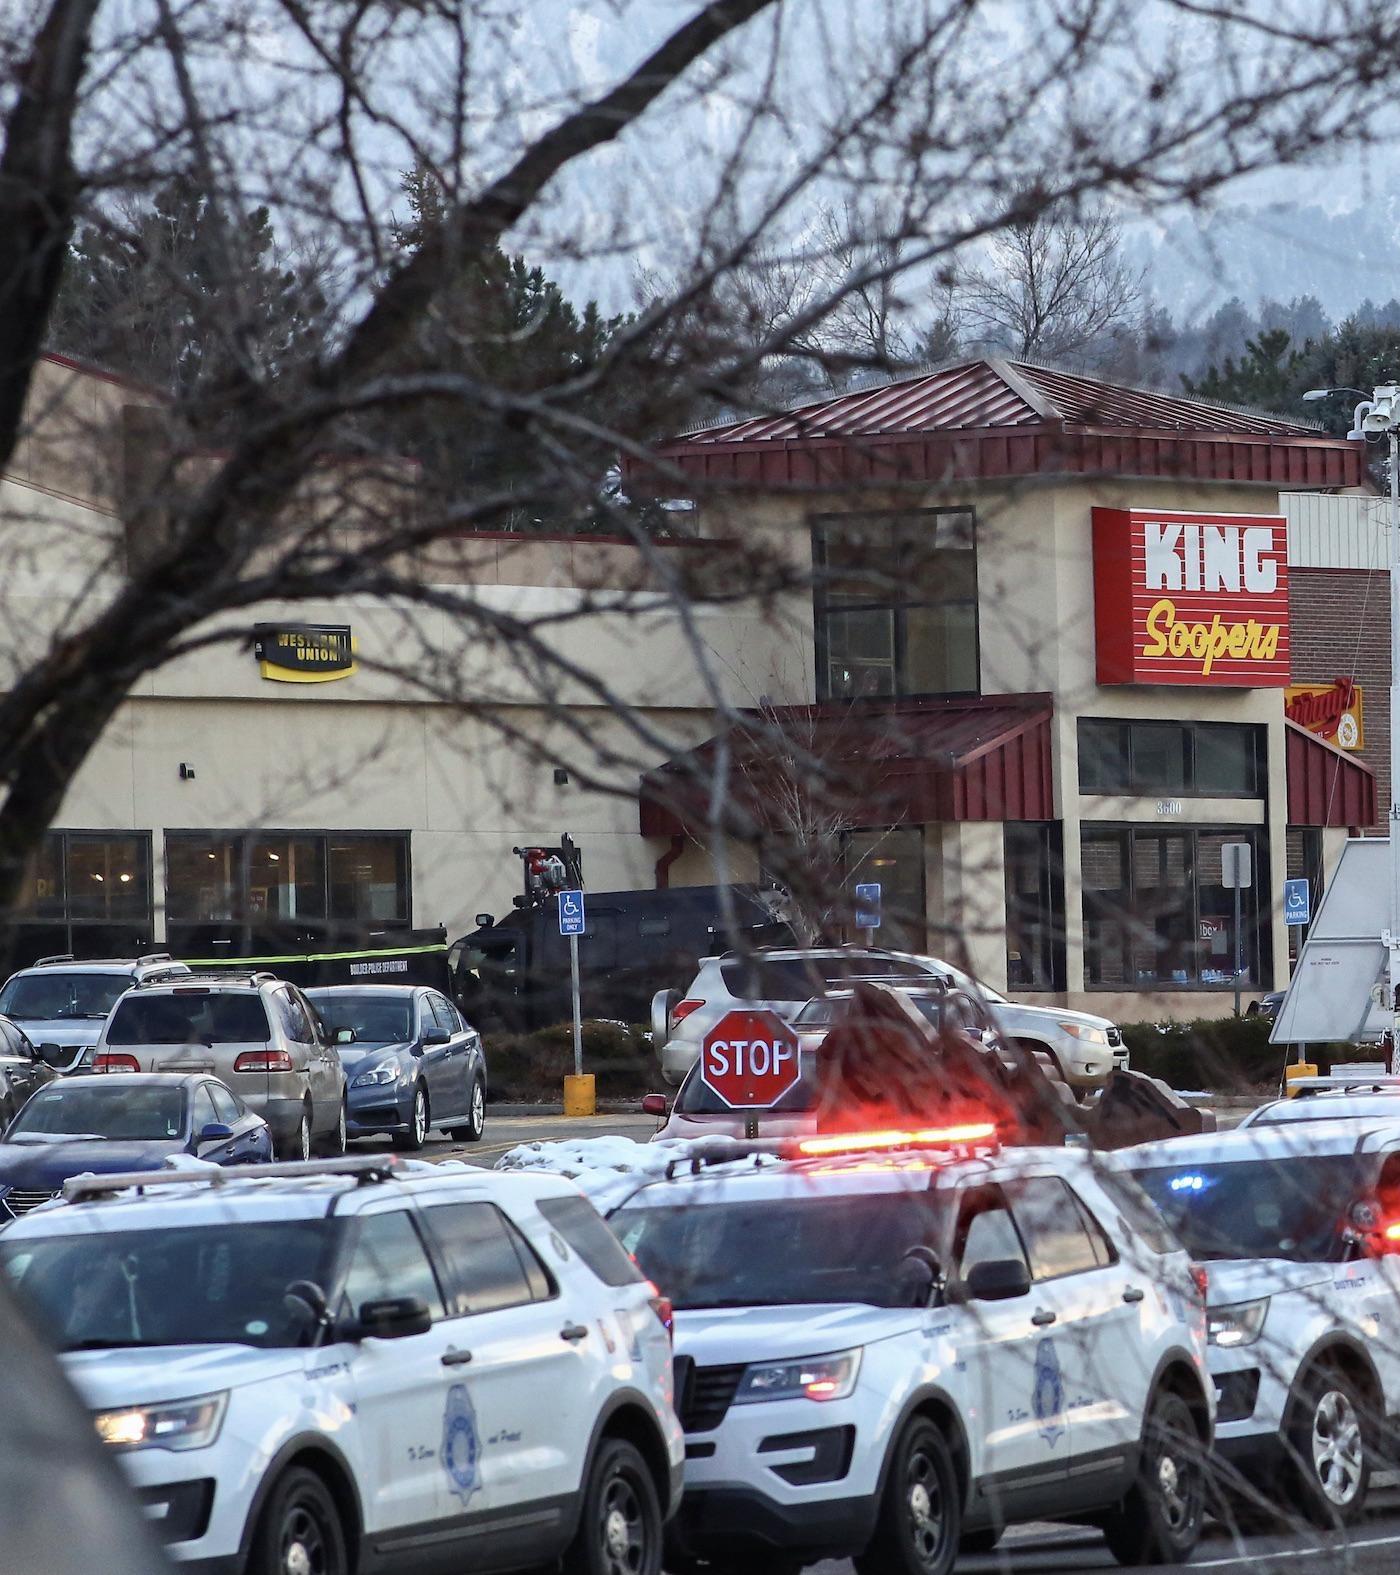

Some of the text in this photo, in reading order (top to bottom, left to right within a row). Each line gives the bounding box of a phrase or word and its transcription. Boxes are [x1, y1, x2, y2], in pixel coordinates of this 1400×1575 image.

[1144, 523, 1277, 593] KING
[1143, 599, 1279, 675] Soopers
[297, 647, 338, 661] UNION
[1157, 801, 1182, 815] 3600
[1286, 911, 1308, 919] PARKING
[709, 1040, 793, 1077] STOP
